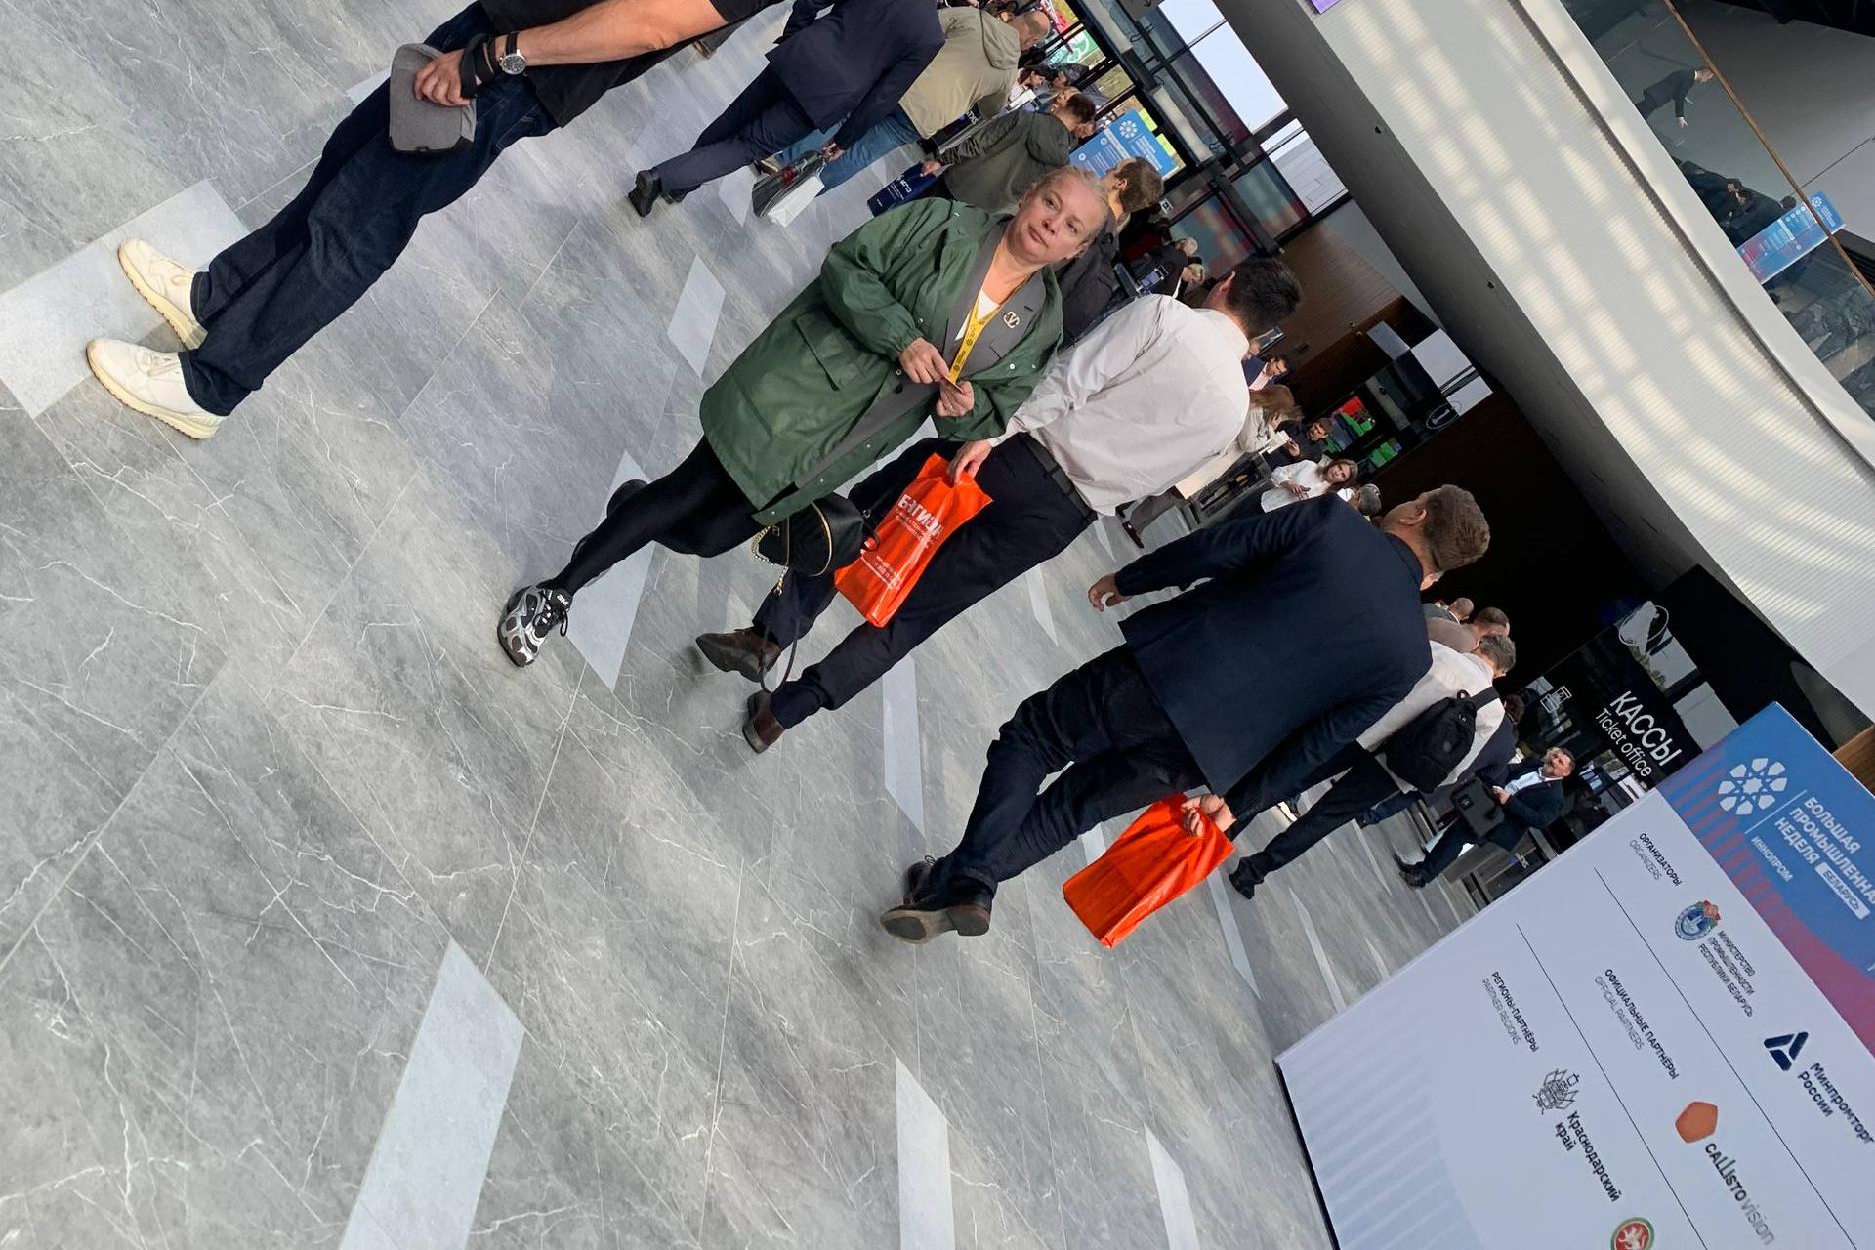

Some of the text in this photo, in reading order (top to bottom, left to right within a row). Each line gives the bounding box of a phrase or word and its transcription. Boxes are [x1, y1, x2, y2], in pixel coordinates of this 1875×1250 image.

[1593, 707, 1654, 779] Ticket office
[1608, 689, 1683, 768] КАССЫ
[1627, 838, 1662, 881] ORGANIZERS
[1638, 832, 1682, 887] ОРГАНИЗАТОРЫ
[1750, 835, 1793, 883] ИННОПРОМ
[1803, 797, 1861, 855] БОЛЬШАЯ
[1773, 816, 1860, 911] НЕДЕЛЯ БЕЛАРУСЬ
[1697, 943, 1755, 1018] РЕСПУБЛИКИ БЕЛАРУСЬ
[1707, 936, 1754, 995] ПРОМЫШЛЕННОСТИ
[1717, 930, 1756, 977] МИНИСТЕРСТВО
[1481, 978, 1522, 1046] PARTNER REGIONS
[1490, 971, 1540, 1053] РЕГИОНЫ-ПАРТНЁРЫ
[1593, 975, 1645, 1051] OFFICIAL PARTNERS
[1603, 968, 1680, 1080] ОФИЦИАЛЬНЫЕ ПАРТНЁРЫ
[1796, 1071, 1835, 1118] России
[1808, 1062, 1873, 1147] Минпромторг
[1554, 1122, 1577, 1152] край
[1565, 1110, 1623, 1203] Краснодарский
